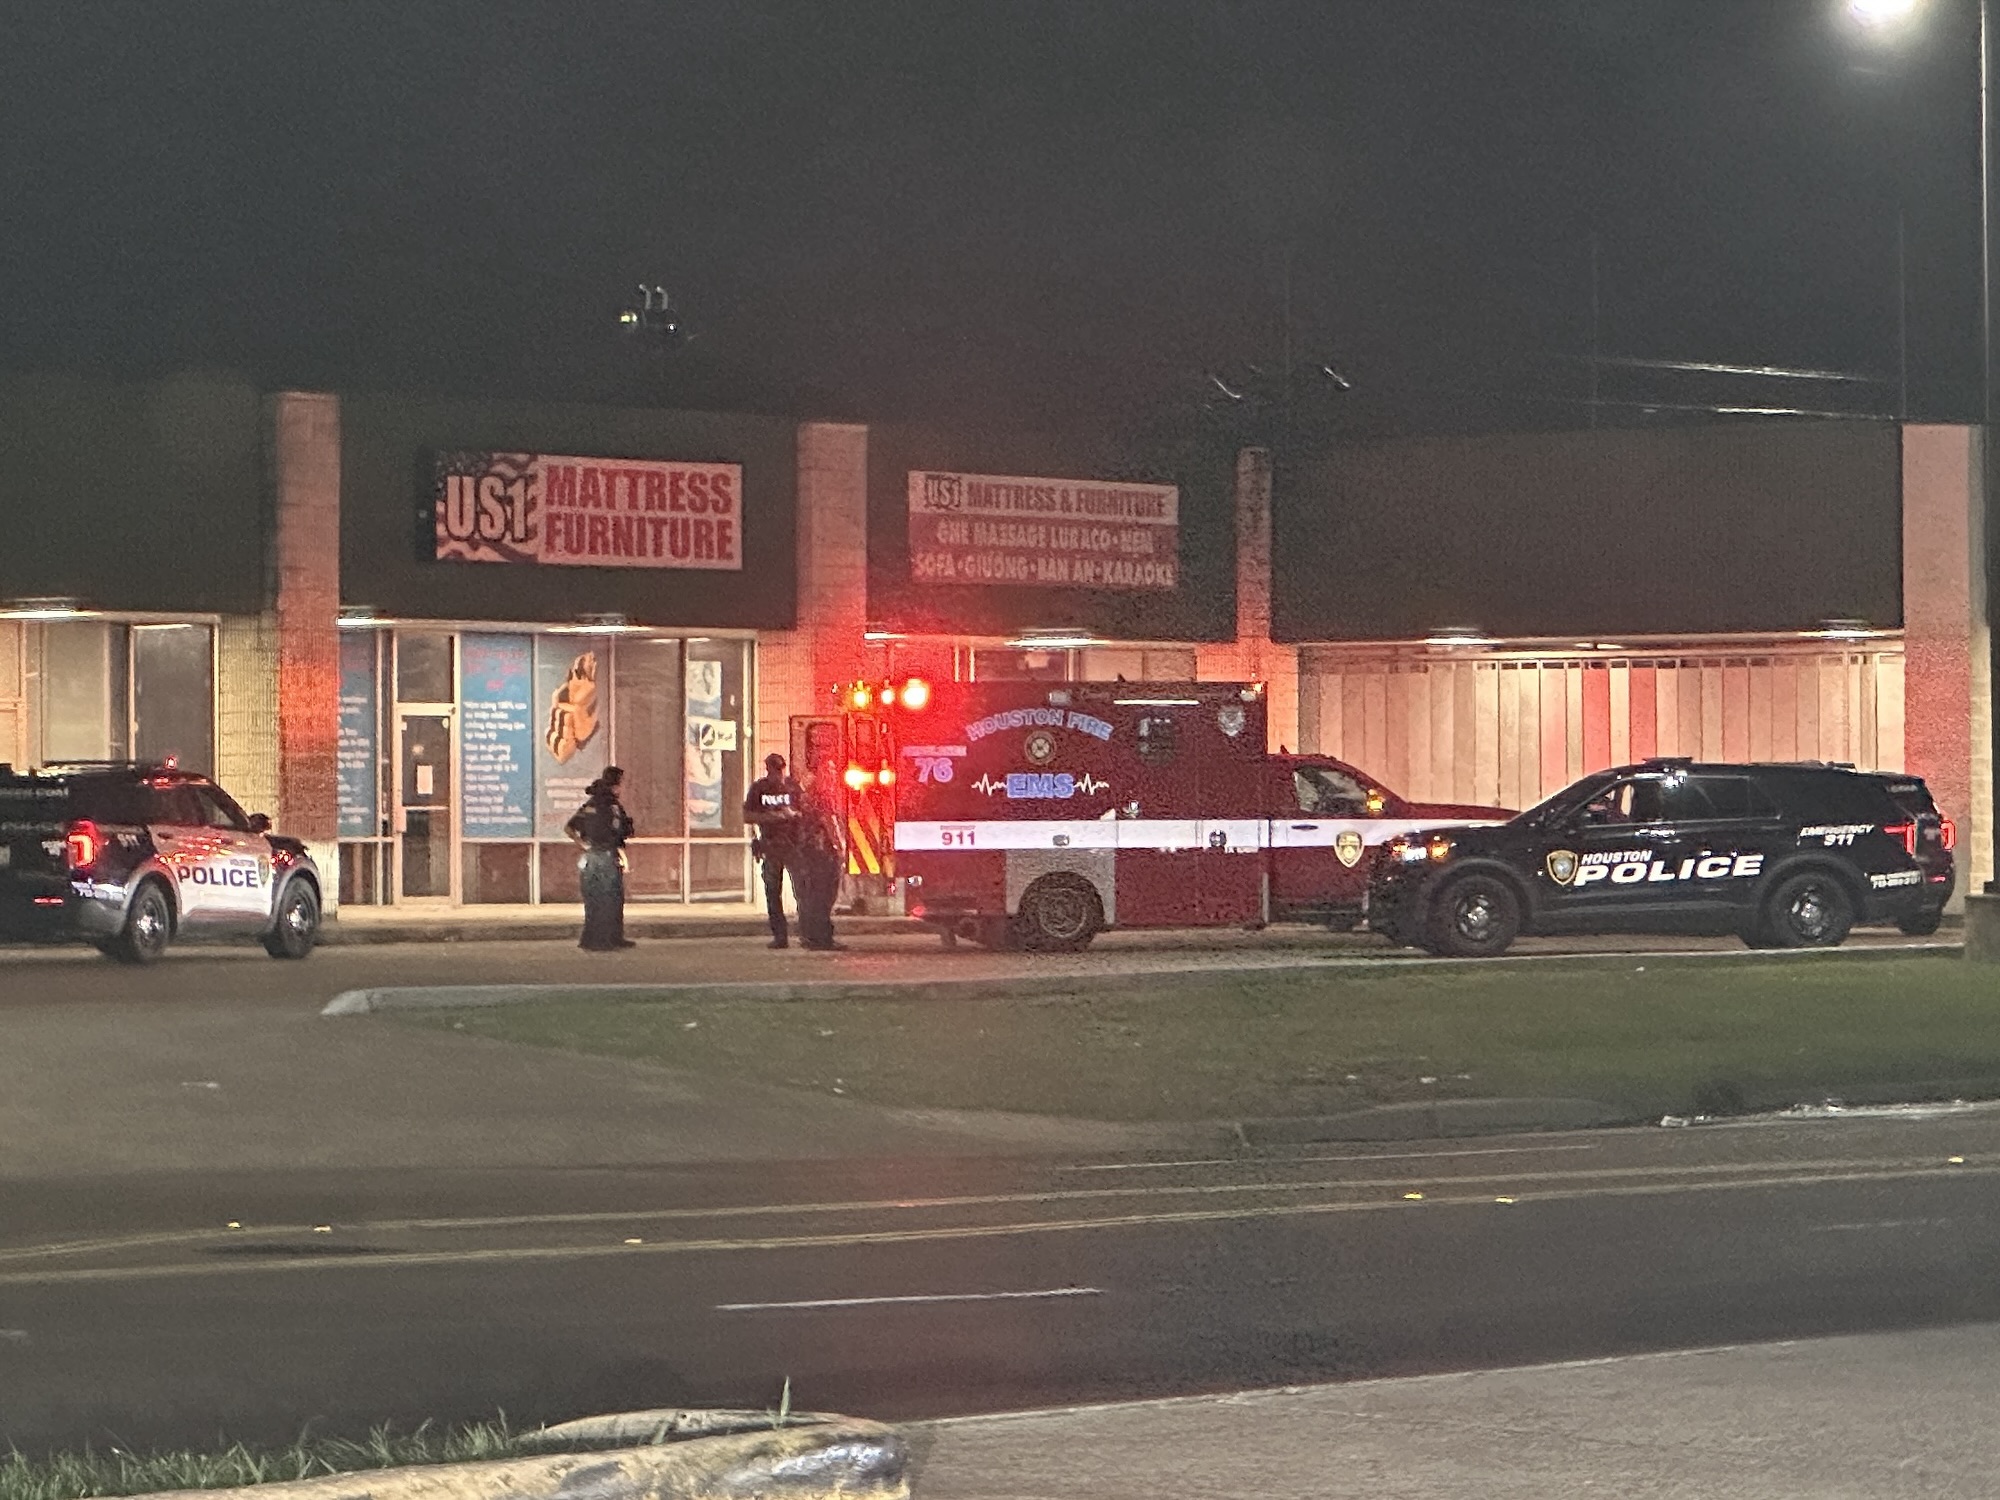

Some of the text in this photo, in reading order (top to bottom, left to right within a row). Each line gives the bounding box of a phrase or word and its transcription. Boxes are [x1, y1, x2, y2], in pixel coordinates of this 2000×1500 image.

[545, 465, 733, 514] MATTRESS
[926, 475, 962, 510] US1
[967, 480, 1057, 511] MATTRESS
[1076, 488, 1167, 517] FURNITURE
[446, 475, 527, 541] US1
[545, 512, 734, 560] FURNITURE
[973, 522, 1046, 548] MASSAGE
[965, 708, 1115, 742] HOUSTON FIRE
[914, 757, 954, 784] 76
[1006, 772, 1076, 798] EMS
[942, 831, 976, 846] 911
[1824, 834, 1855, 847] 911
[1573, 855, 1764, 887] POLICE
[1581, 850, 1653, 866] HOUSTON
[177, 865, 259, 889] POLICE
